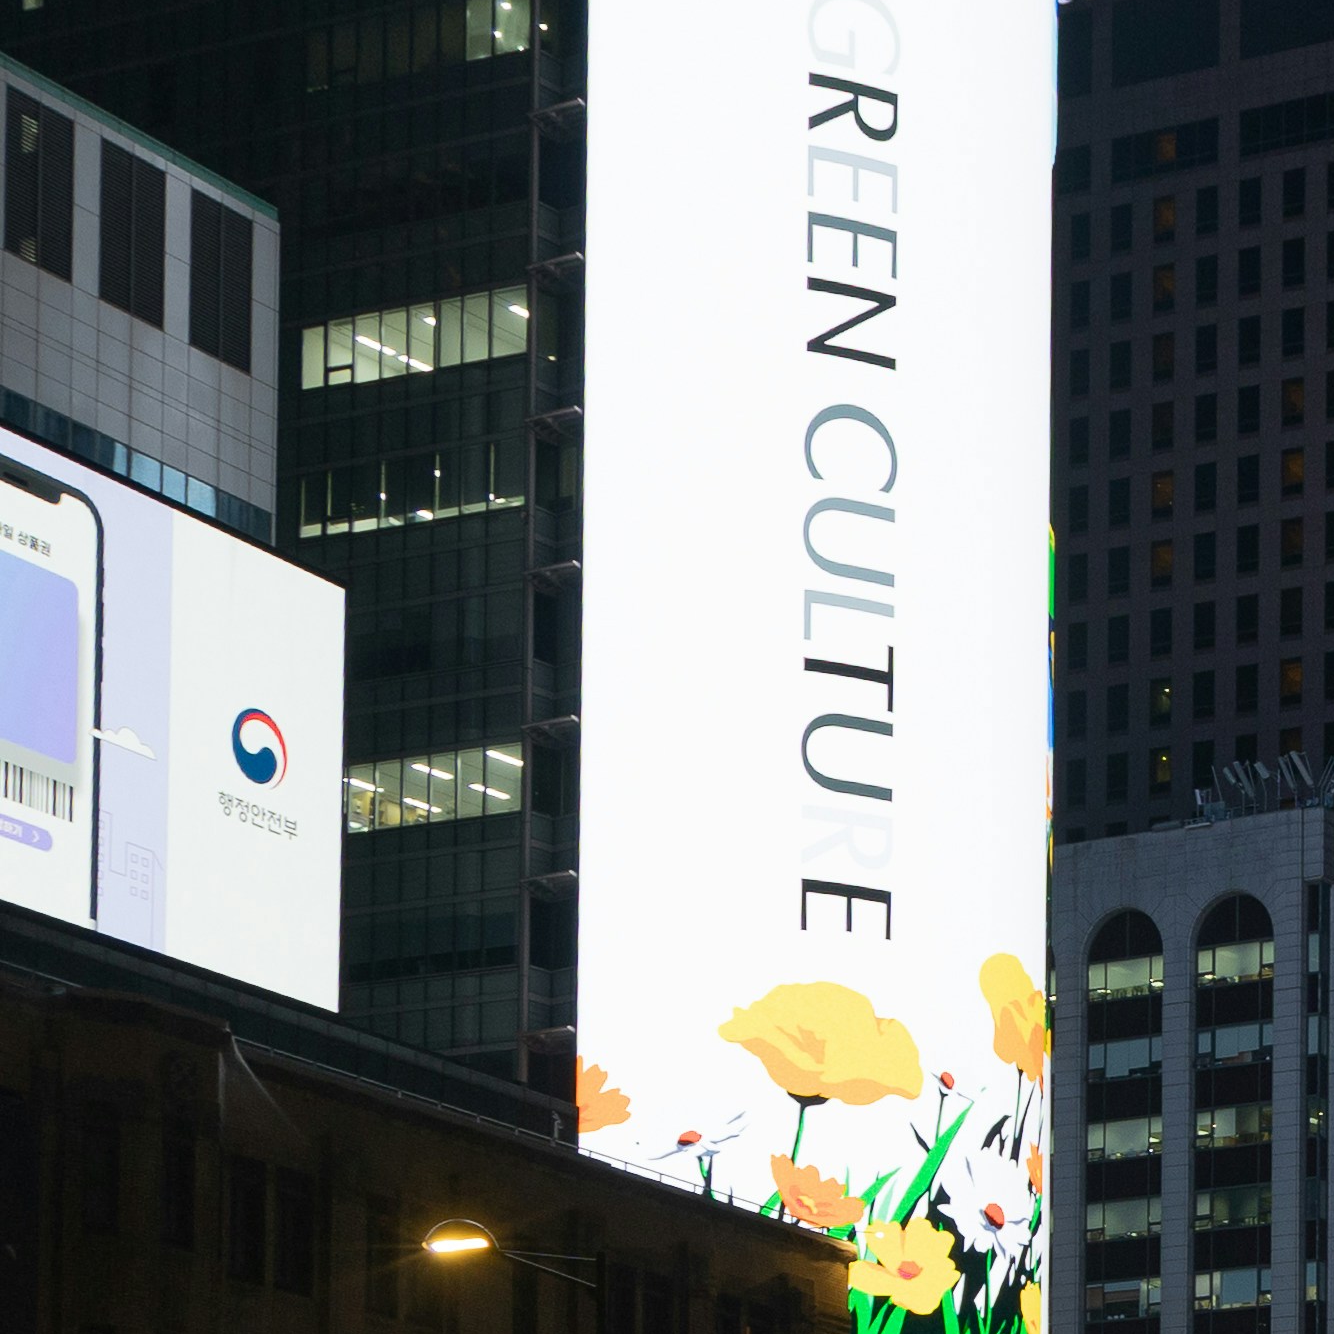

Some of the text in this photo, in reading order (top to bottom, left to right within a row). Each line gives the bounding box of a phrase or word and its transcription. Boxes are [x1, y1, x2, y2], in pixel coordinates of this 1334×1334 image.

[18, 530, 52, 558] 상품권
[800, 403, 898, 941] CULTURE
[218, 791, 298, 840] 행정안전부
